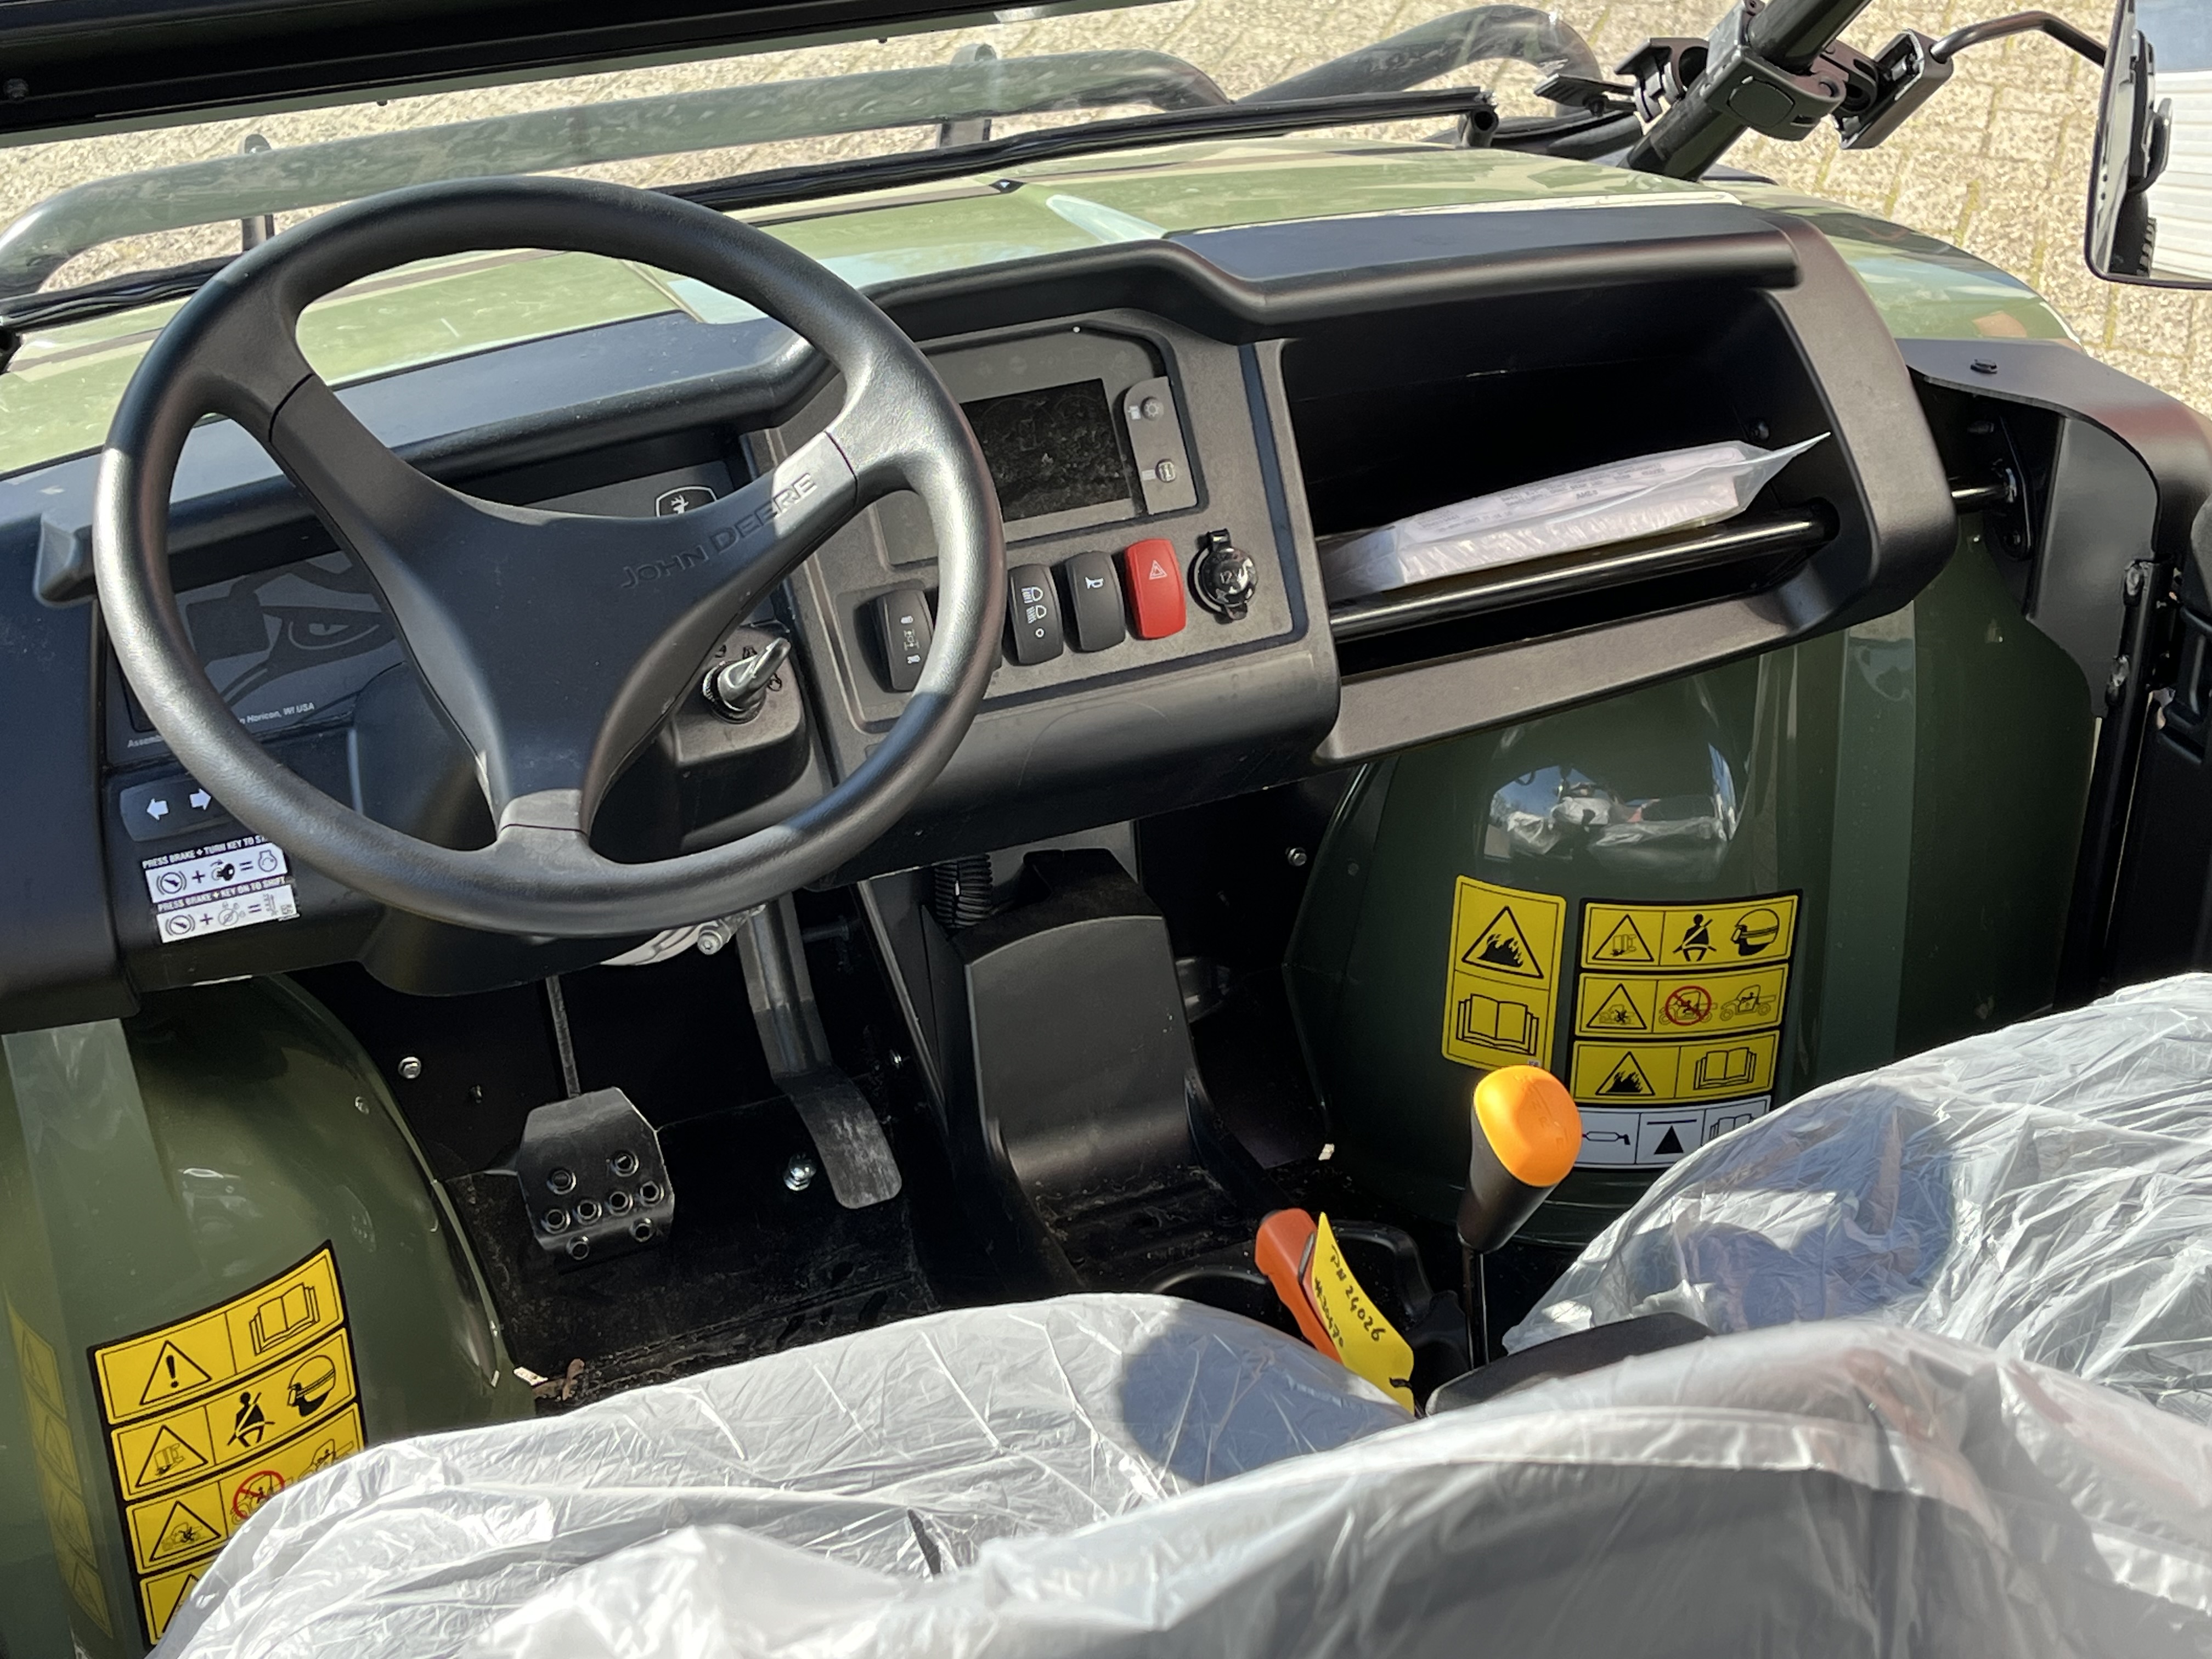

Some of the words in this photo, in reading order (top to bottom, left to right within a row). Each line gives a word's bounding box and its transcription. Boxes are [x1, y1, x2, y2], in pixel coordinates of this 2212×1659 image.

[621, 545, 709, 589] JOHN
[709, 473, 817, 555] DEERE
[247, 711, 282, 723] Horicon,
[283, 707, 295, 715] WI
[296, 702, 315, 713] USA
[142, 855, 168, 868] PRESS
[171, 850, 195, 862] BRAKE
[204, 843, 227, 854] TURN
[227, 839, 242, 850] KEY
[242, 836, 254, 847] TO
[157, 899, 184, 912] PRESS
[185, 892, 211, 906] BRAKE
[221, 886, 236, 897] KEY
[251, 881, 262, 891] TO
[1345, 1285, 1386, 1341] 24026
